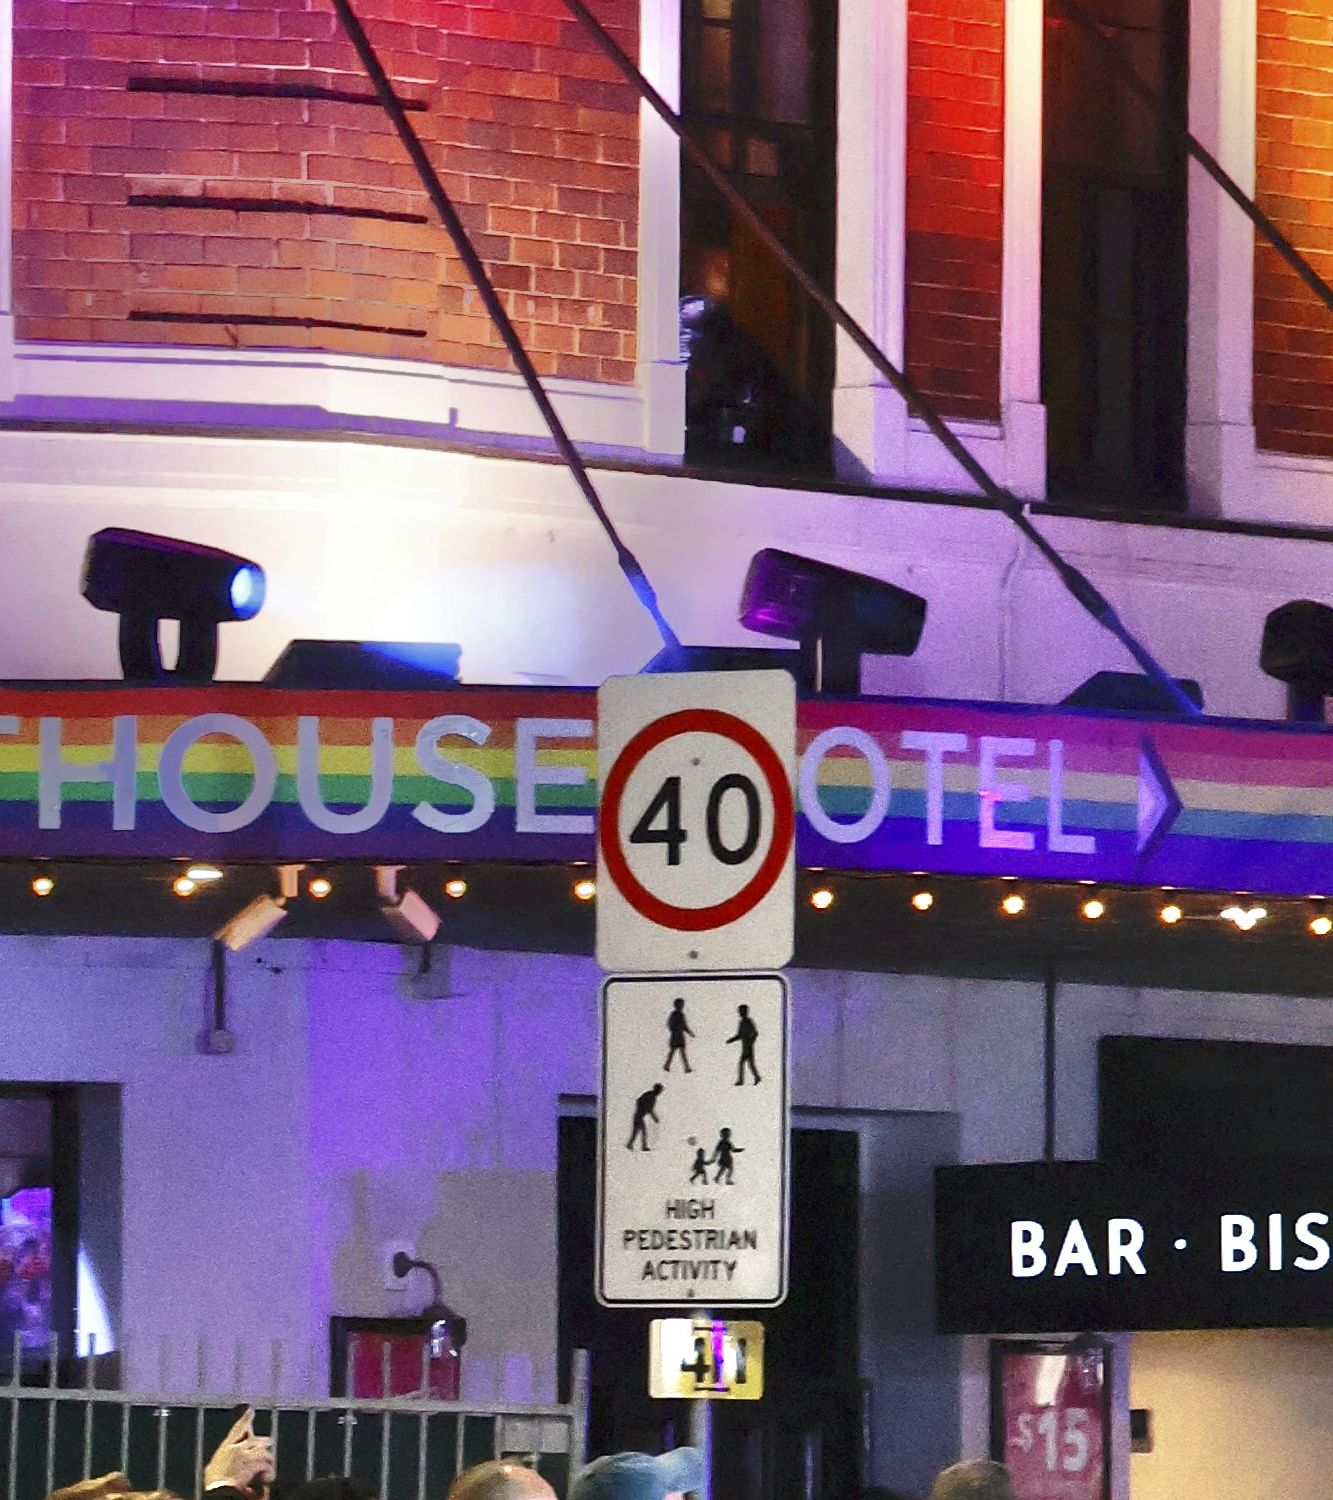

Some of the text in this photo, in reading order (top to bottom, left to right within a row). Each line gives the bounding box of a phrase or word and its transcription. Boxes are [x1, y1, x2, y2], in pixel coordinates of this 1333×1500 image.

[630, 773, 762, 866] 40
[798, 726, 1096, 854] OTEL
[665, 1198, 715, 1220] HIGH
[622, 1229, 758, 1251] PEDESTRIAN
[1010, 1218, 1148, 1278] BAR
[640, 1259, 737, 1282] ACTIVITY
[1008, 1406, 1090, 1473] $15
